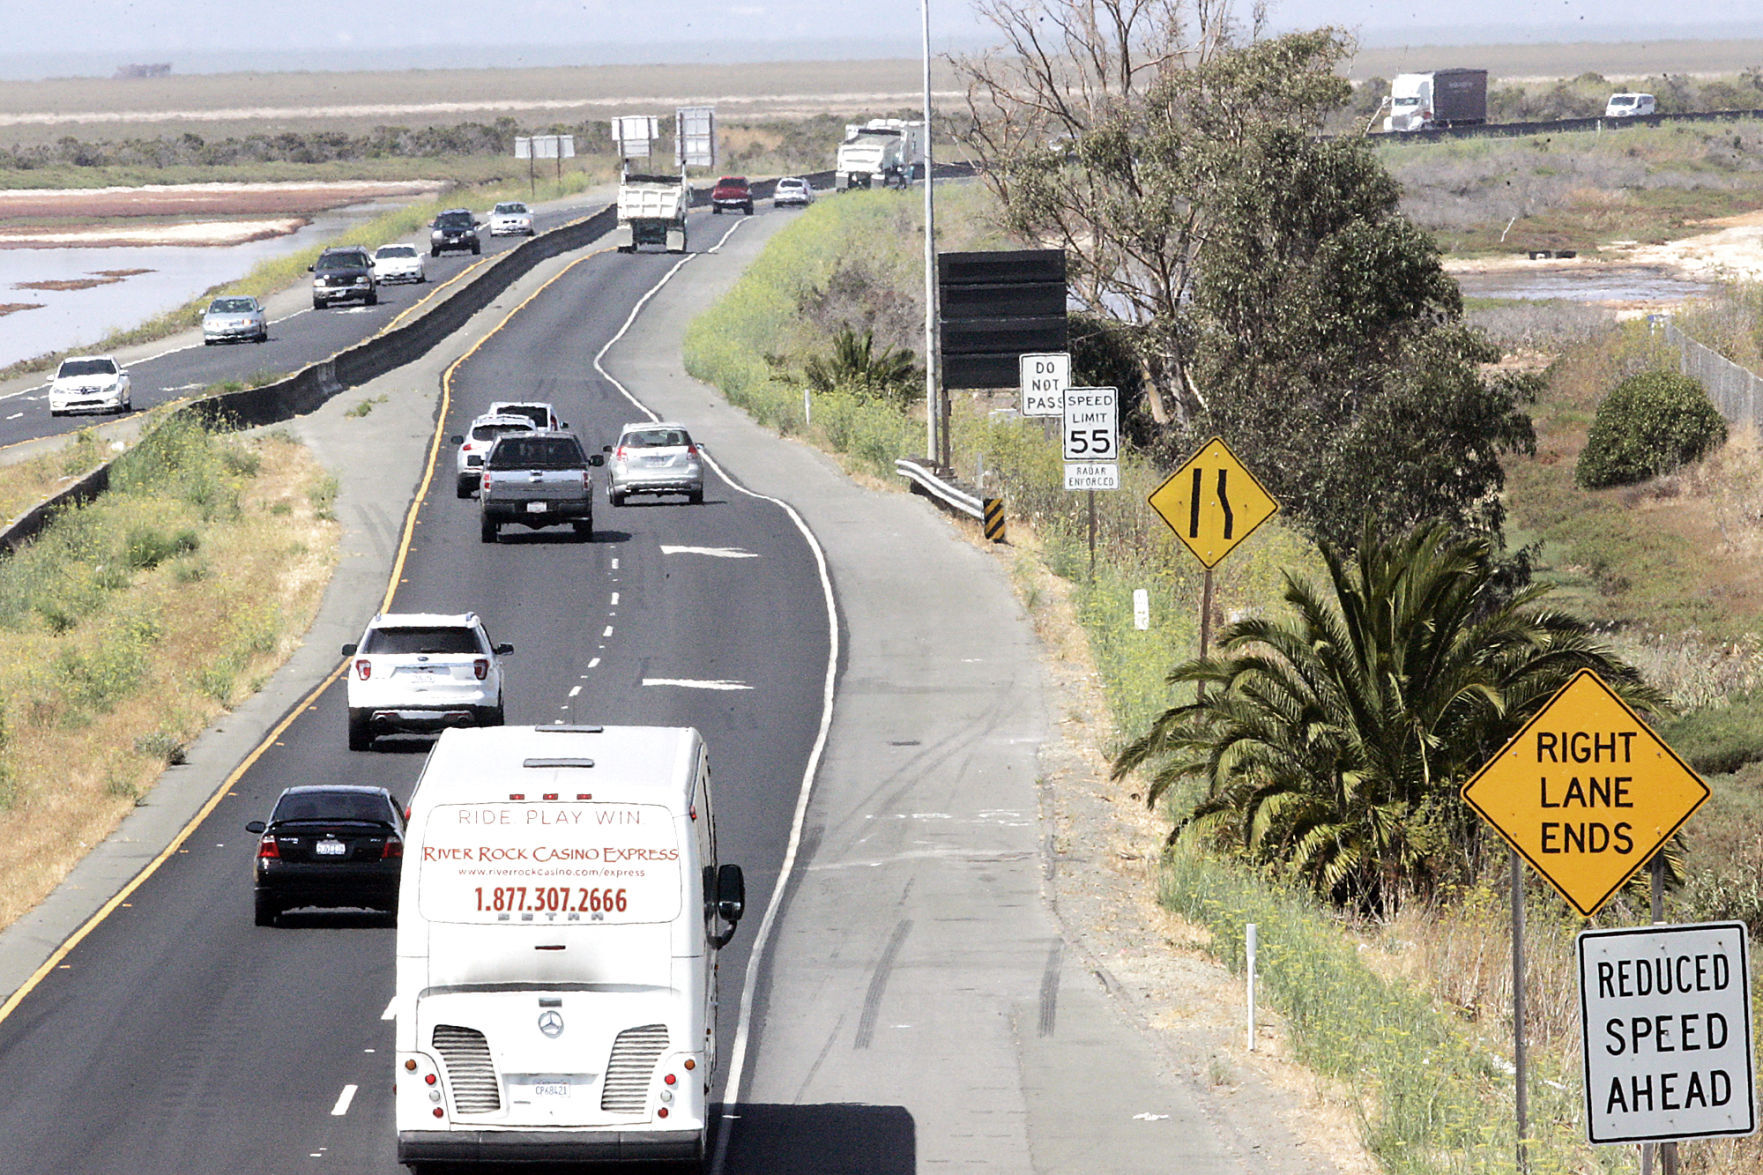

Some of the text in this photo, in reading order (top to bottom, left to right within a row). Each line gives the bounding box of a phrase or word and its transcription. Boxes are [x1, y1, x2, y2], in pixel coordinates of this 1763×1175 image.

[1036, 362, 1055, 374] DO
[1032, 379, 1059, 391] NOT
[1068, 395, 1113, 406] SPEED
[1072, 413, 1108, 423] LIMIT
[1070, 429, 1110, 454] 55
[1076, 466, 1107, 475] RADAR
[1069, 477, 1114, 487] ENFORCED
[1537, 732, 1638, 763] RIGHT
[1540, 777, 1634, 808] LANE
[458, 809, 641, 825] RIDE PLAY WIN
[1541, 822, 1634, 854] ENDS
[423, 846, 679, 863] RIVER ROCK CASINO EXPRESS
[474, 886, 628, 913] 1.877.307.2666
[1598, 953, 1731, 999] REDUCED
[1606, 1012, 1729, 1056] SPEED
[1606, 1069, 1732, 1115] AHEAD
